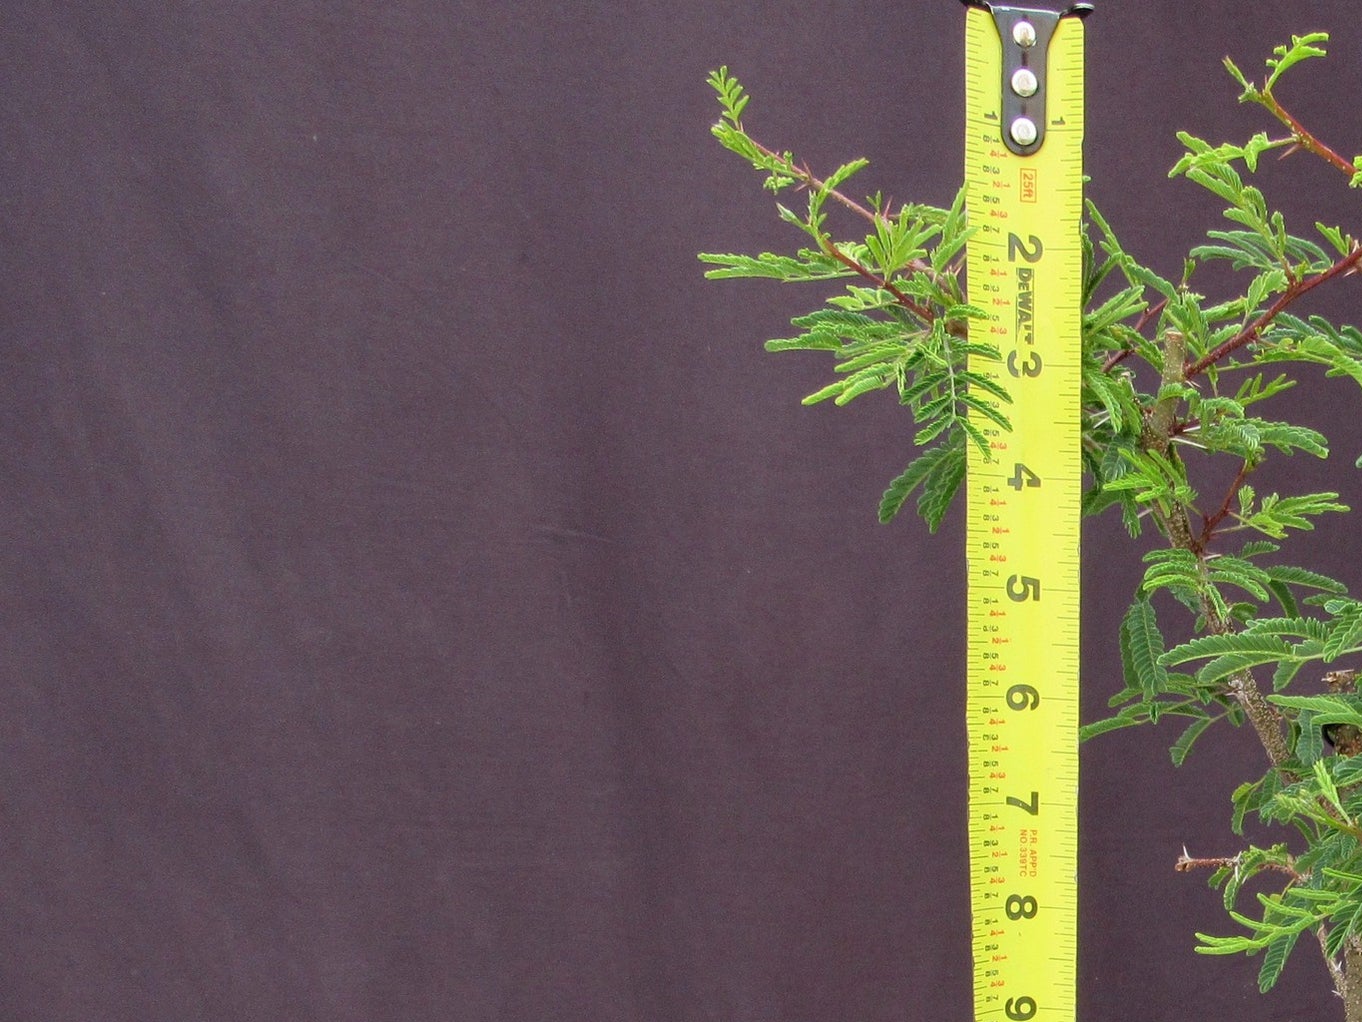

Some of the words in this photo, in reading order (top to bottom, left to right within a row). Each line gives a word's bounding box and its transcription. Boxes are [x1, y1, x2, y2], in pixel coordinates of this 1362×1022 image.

[984, 111, 997, 120] 1
[1052, 117, 1066, 125] 1
[1023, 174, 1034, 198] 25ft
[1008, 232, 1043, 263] 2
[1007, 350, 1042, 378] 3
[1007, 463, 1041, 491] 4
[1006, 574, 1040, 602] 5
[1006, 684, 1040, 711] 6
[1006, 791, 1039, 816] 7
[1005, 894, 1038, 921] 8
[1005, 996, 1037, 1022] 9
